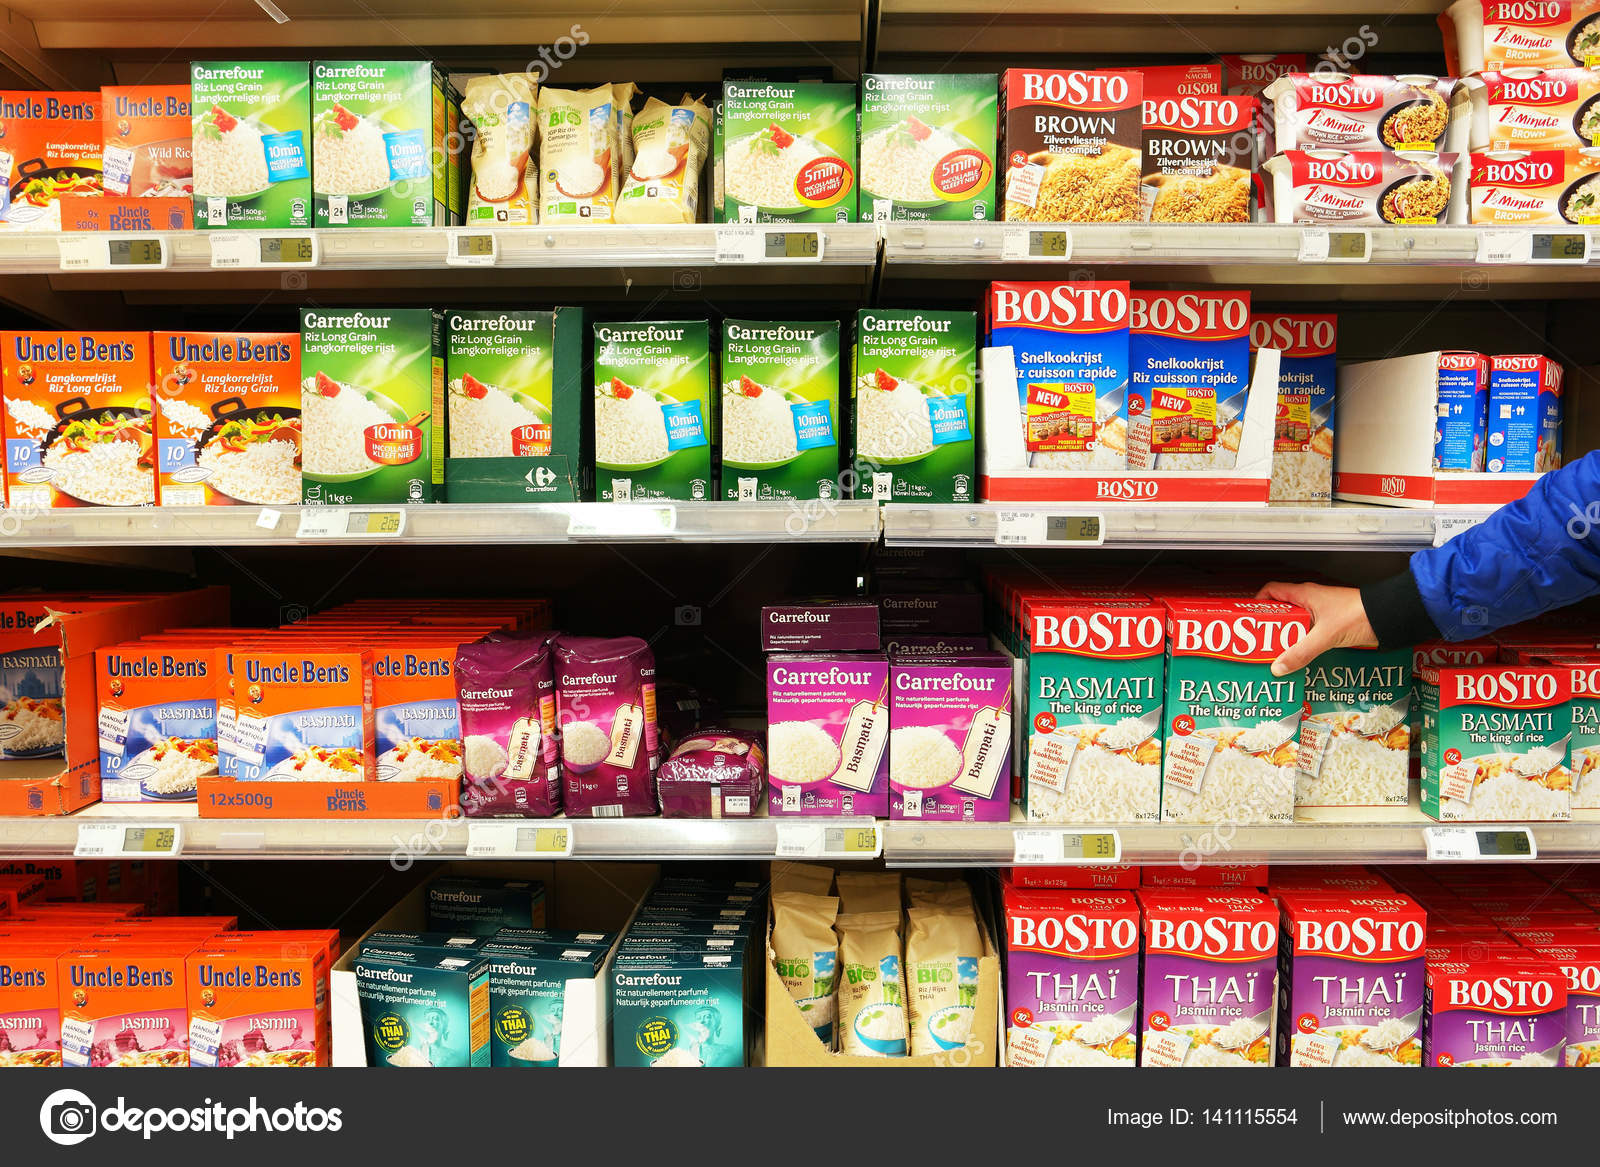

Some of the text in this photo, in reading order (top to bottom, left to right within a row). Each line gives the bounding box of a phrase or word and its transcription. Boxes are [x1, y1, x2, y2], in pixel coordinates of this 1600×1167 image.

[1497, 1, 1560, 21] BOSTO
[1509, 34, 1552, 48] Minute
[1506, 49, 1539, 59] BROWN
[194, 67, 264, 79] Carrefour
[316, 65, 385, 78] Carrefour
[194, 82, 262, 93] Riz Long Grain
[316, 82, 384, 91] Riz Long Grain
[866, 78, 935, 90] Carrefour
[1024, 72, 1128, 105] BOSTO
[1178, 82, 1218, 95] BOSTO
[1504, 80, 1566, 99] BOSTO
[195, 93, 280, 104] Langkorrelige rijst
[316, 92, 401, 102] Langkorrelige rijst
[728, 86, 795, 98] Carrefour
[1312, 84, 1376, 106] BOSTO
[47, 98, 94, 120] Ben's
[116, 97, 162, 116] Uncle
[728, 101, 794, 110] Riz Long Grain
[728, 111, 810, 121] Langkorrelige rijst
[1143, 98, 1238, 129] BOSTO
[1515, 113, 1558, 127] Minute
[1035, 116, 1116, 134] BROWN
[1324, 118, 1365, 133] Minute
[1044, 136, 1107, 146] Zilvervliesrijst
[1512, 129, 1546, 139] BROWN
[148, 148, 172, 158] Wild
[269, 144, 300, 157] 10min
[1049, 145, 1101, 155] Riz complet
[1149, 140, 1226, 156] BROWN
[805, 164, 838, 184] 5min
[1308, 161, 1374, 181] BOSTO
[1487, 161, 1552, 180] BOSTO
[804, 177, 839, 192] INCOLLABLE
[118, 207, 149, 218] Uncle
[197, 210, 207, 218] 4x
[1494, 211, 1530, 220] BROWN
[77, 221, 98, 230] 500g
[996, 286, 1127, 326] BOSTO
[305, 313, 391, 328] Carrefour
[1130, 295, 1247, 332] BOSTO
[451, 316, 535, 330] Carrefour
[863, 316, 951, 332] Carrefour
[305, 333, 376, 343] Riz Long Grain
[600, 327, 684, 342] Carrefour
[728, 326, 814, 341] Carrefour
[863, 335, 877, 345] Riz
[1250, 316, 1334, 350] OSTO
[16, 337, 134, 361] Uncle Ben's
[170, 337, 291, 361] Uncle Ben's
[1021, 352, 1102, 365] Snelkookrijst
[1148, 358, 1224, 371] Snelkookrijst
[1494, 357, 1538, 370] BOSTO
[46, 374, 116, 384] Langkorrelrijst
[1028, 367, 1117, 380] cuisson rapide
[1154, 373, 1237, 385] cuisson rapide
[1064, 383, 1093, 392] BOSTO
[1187, 389, 1214, 398] BOSTO
[1036, 391, 1063, 406] NEW
[1160, 397, 1185, 411] NEW
[668, 415, 698, 426] 10min
[373, 426, 413, 439] 10min
[14, 446, 30, 460] 10
[168, 446, 184, 460] 10
[372, 443, 414, 452] INCOLLABLE
[1096, 481, 1158, 500] BOSTO
[1382, 477, 1405, 494] BOSTO
[603, 490, 612, 499] 5x
[883, 599, 938, 609] Carrefour
[770, 612, 830, 624] Carrefour
[1035, 612, 1163, 651] BOSTO
[1177, 617, 1306, 656] BOSTO
[3, 656, 57, 669] BASMATI
[108, 655, 207, 676] Uncle Ben's
[404, 654, 449, 676] Ben's
[246, 660, 349, 683] Uncle Ben's
[773, 668, 871, 685] Carrefour
[1305, 667, 1403, 687] BASMATI
[562, 673, 617, 686] Carrefour
[896, 673, 994, 691] Carrefour
[461, 688, 513, 700] Carrefour
[1040, 677, 1154, 699] BASMATI
[1180, 681, 1294, 702] BASMATI
[1456, 672, 1557, 703] BOSTO
[159, 708, 213, 720] BASMATI
[1050, 702, 1142, 715] The king of rice
[1260, 707, 1281, 717] rice
[1461, 714, 1552, 731] BASMATI
[616, 719, 632, 759] Basmati
[847, 717, 874, 773] Basmati
[1526, 734, 1544, 742] rice
[969, 722, 997, 778] Basmati
[209, 793, 272, 808] 12x500g
[336, 789, 364, 799] Uncle
[328, 797, 367, 811] Ben's
[1012, 915, 1137, 952] BOSTO
[1150, 917, 1276, 955] BOSTO
[1298, 918, 1423, 955] BOSTO
[70, 965, 173, 987] Uncle Ben's
[199, 965, 301, 987] Uncle Ben's
[356, 966, 413, 983] Carrefour
[917, 969, 952, 983] BIO
[1027, 969, 1120, 1000] THAÏ
[1165, 973, 1258, 1003] THAÏ
[1313, 972, 1406, 1004] THAÏ
[682, 988, 708, 998] parfumé
[616, 998, 701, 1007] Natuurlijk geparfumeerde
[1038, 1001, 1078, 1013] Jasmin
[1474, 1043, 1507, 1053] Jasmin
